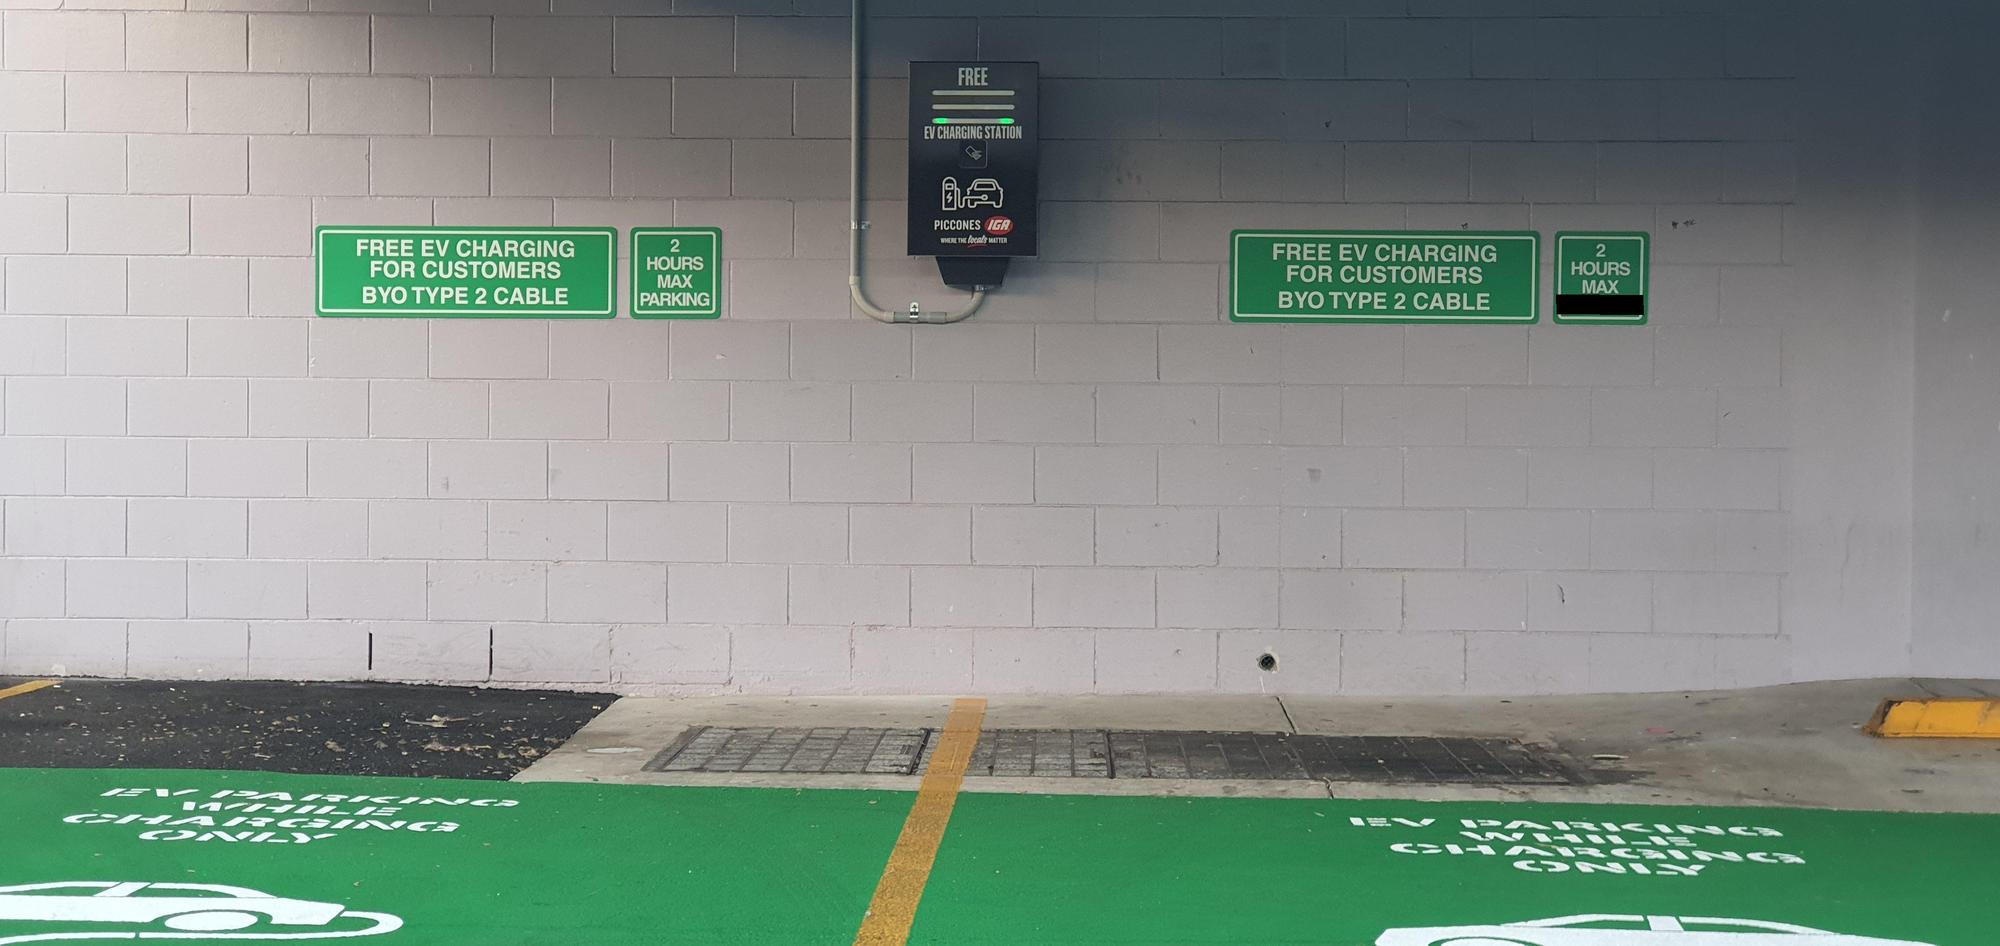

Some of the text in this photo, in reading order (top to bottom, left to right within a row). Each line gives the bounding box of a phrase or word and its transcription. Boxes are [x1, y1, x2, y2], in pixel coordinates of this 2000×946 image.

[958, 67, 988, 86] FREE
[924, 125, 1022, 140] EV CHARGING STATION
[934, 219, 1011, 231] PICCONES IGA
[670, 239, 680, 253] 2
[967, 234, 987, 245] locals
[356, 239, 575, 258] FREE EV CHARGING
[1272, 243, 1497, 263] FREE EV CHARGING
[1595, 243, 1606, 258] 2
[370, 260, 561, 279] FOR CUSTOMERS
[646, 256, 704, 271] HOURS
[1571, 261, 1631, 276] HOURS
[657, 274, 693, 289] MAX
[1286, 265, 1483, 284] FOR CUSTOMERS
[1582, 279, 1619, 294] MAX
[362, 286, 568, 305] BYO TYPE 2 CABLE
[640, 292, 710, 307] PARKING
[1278, 291, 1491, 311] BYO TYPE 2 CABLE
[101, 788, 519, 807] EV PARKING
[182, 801, 402, 816] WHILE
[63, 813, 460, 832] CHARGING
[1349, 817, 1783, 836] EV PARKING
[138, 829, 337, 844] ONLY
[1459, 831, 1698, 846] WHILE
[1390, 843, 1805, 864] CHARGING
[1513, 860, 1706, 876] ONLY
